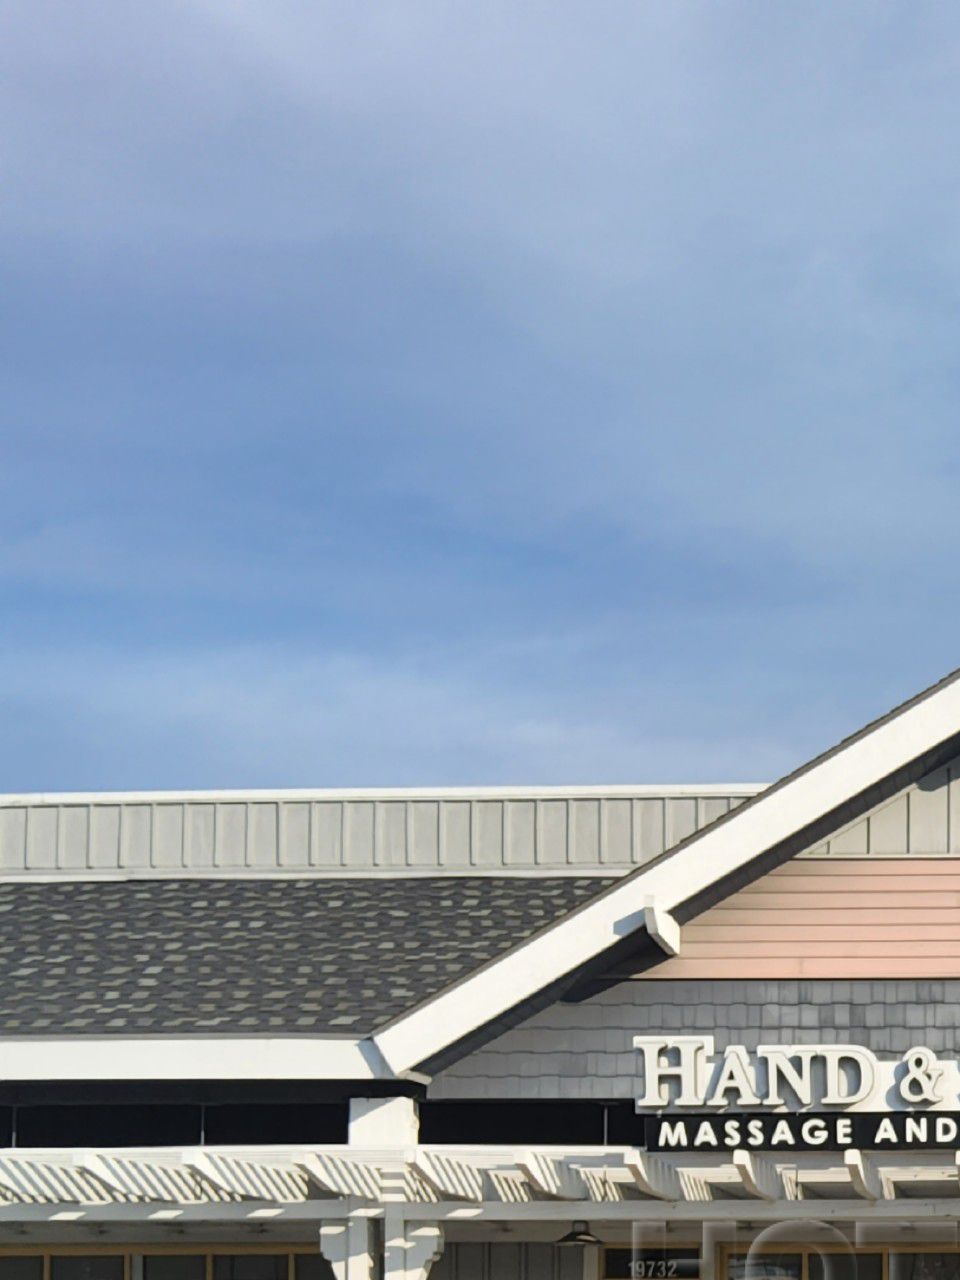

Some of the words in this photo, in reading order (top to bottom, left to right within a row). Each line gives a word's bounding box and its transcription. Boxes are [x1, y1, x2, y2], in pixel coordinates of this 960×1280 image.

[634, 1036, 876, 1106] HAND
[900, 1051, 943, 1103] &
[658, 1118, 852, 1147] MASSAGE
[874, 1117, 958, 1144] AND
[628, 1260, 677, 1278] 19732
